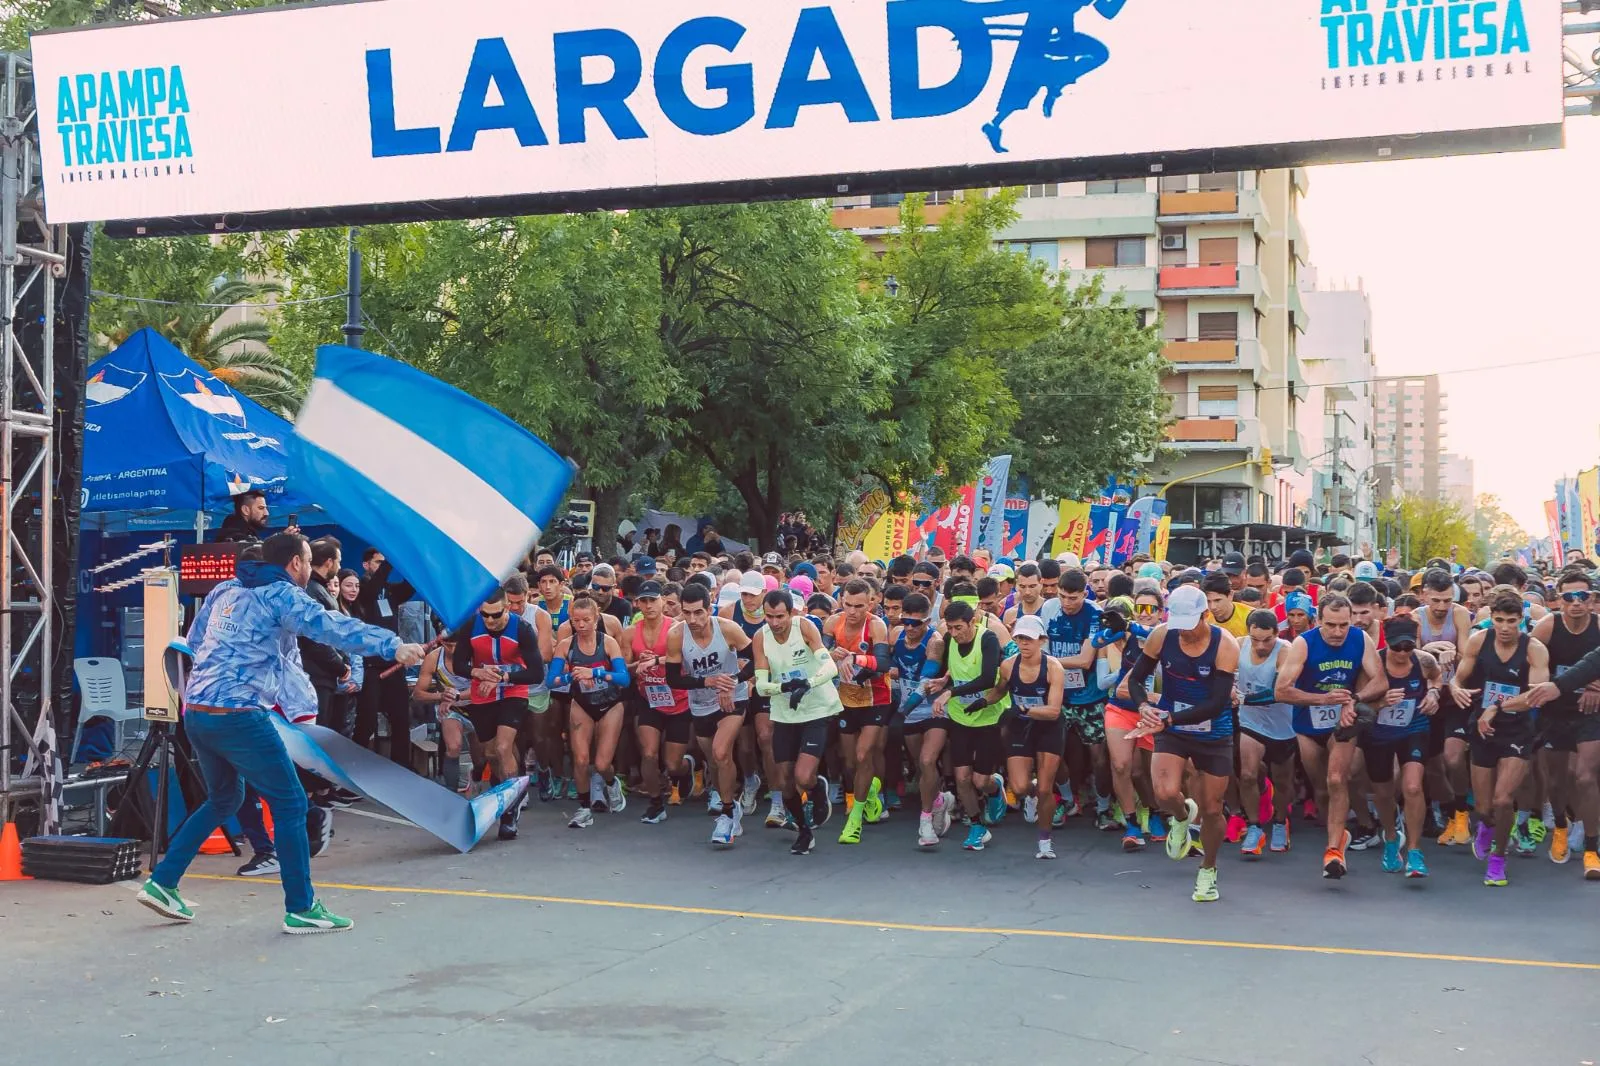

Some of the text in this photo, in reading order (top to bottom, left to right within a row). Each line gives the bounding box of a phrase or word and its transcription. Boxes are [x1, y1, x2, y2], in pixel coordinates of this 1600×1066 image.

[1320, 1, 1531, 69] TRAVIESA
[1320, 60, 1532, 90] INTERNACIONAL
[57, 65, 190, 124] APAMPA
[57, 116, 193, 168] TRAVIESA
[61, 163, 196, 184] INTERNACIONAL
[117, 467, 168, 480] ARGENTINA
[1052, 641, 1080, 654] APAMP
[692, 651, 720, 670] MR
[650, 692, 671, 702] 855
[1319, 708, 1336, 722] 20
[1389, 709, 1405, 720] 12
